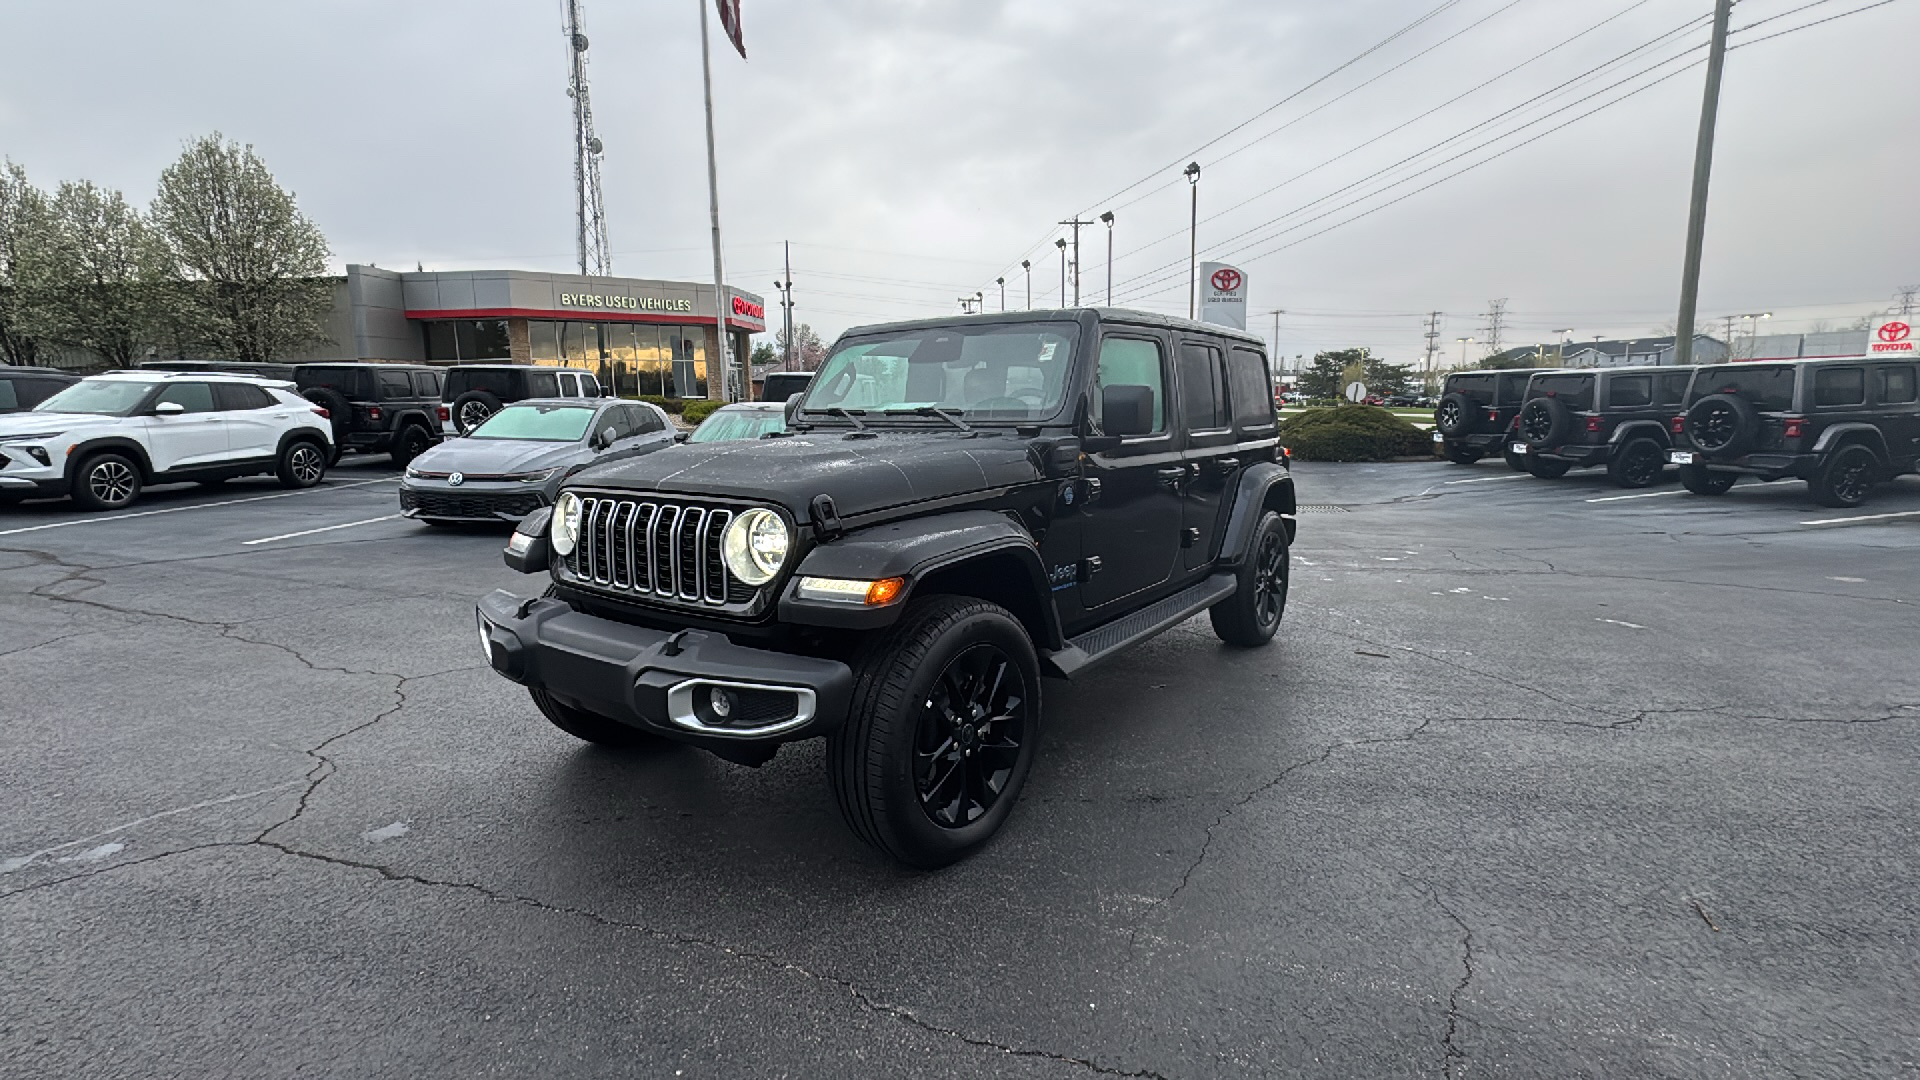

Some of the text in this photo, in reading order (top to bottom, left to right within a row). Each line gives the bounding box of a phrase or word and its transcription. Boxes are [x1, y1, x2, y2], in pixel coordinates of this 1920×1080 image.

[561, 293, 691, 311] BYERS USED VEHICLES
[742, 301, 764, 319] TOYOTA
[1871, 343, 1913, 352] TOYOTA
[1049, 563, 1077, 580] Jeep
